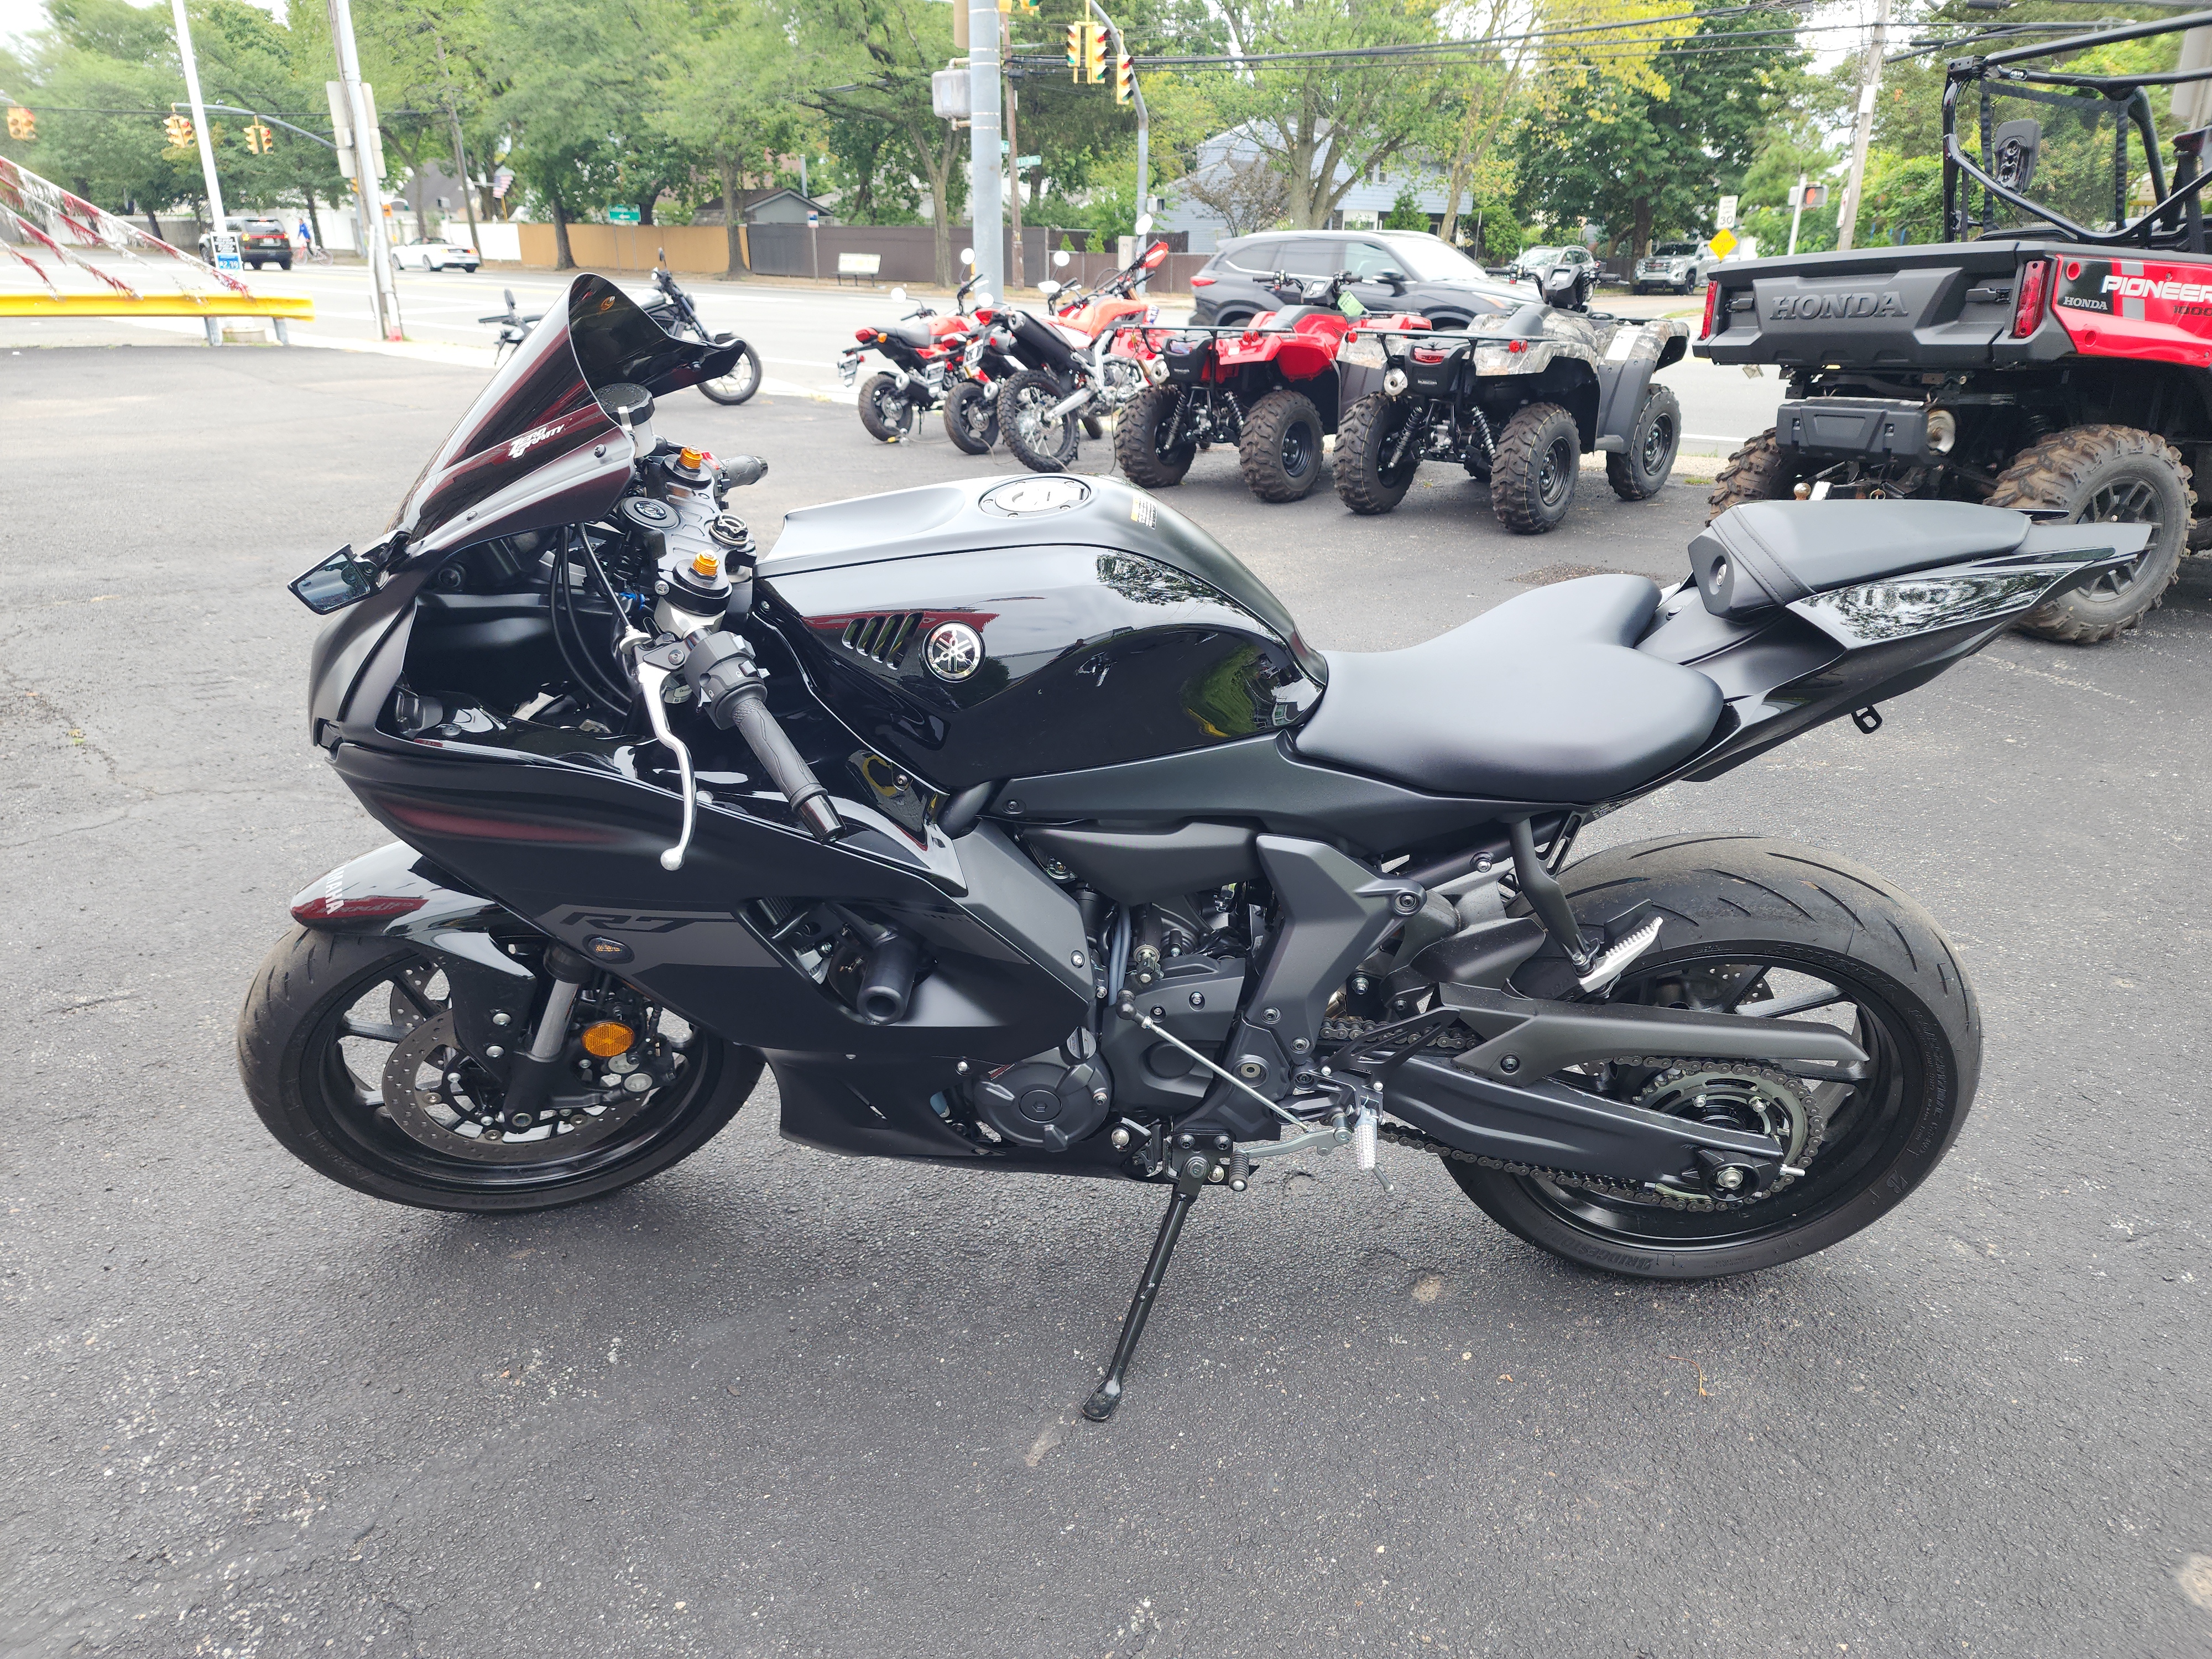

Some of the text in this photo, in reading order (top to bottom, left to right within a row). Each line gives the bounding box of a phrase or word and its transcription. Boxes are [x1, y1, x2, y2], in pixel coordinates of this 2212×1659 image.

[1720, 216, 1733, 225] 30
[1770, 291, 1908, 320] HONDA
[2063, 296, 2108, 310] HONDA
[508, 427, 547, 456] ZERO
[512, 424, 565, 458] GRAVITY
[560, 912, 738, 933] R7
